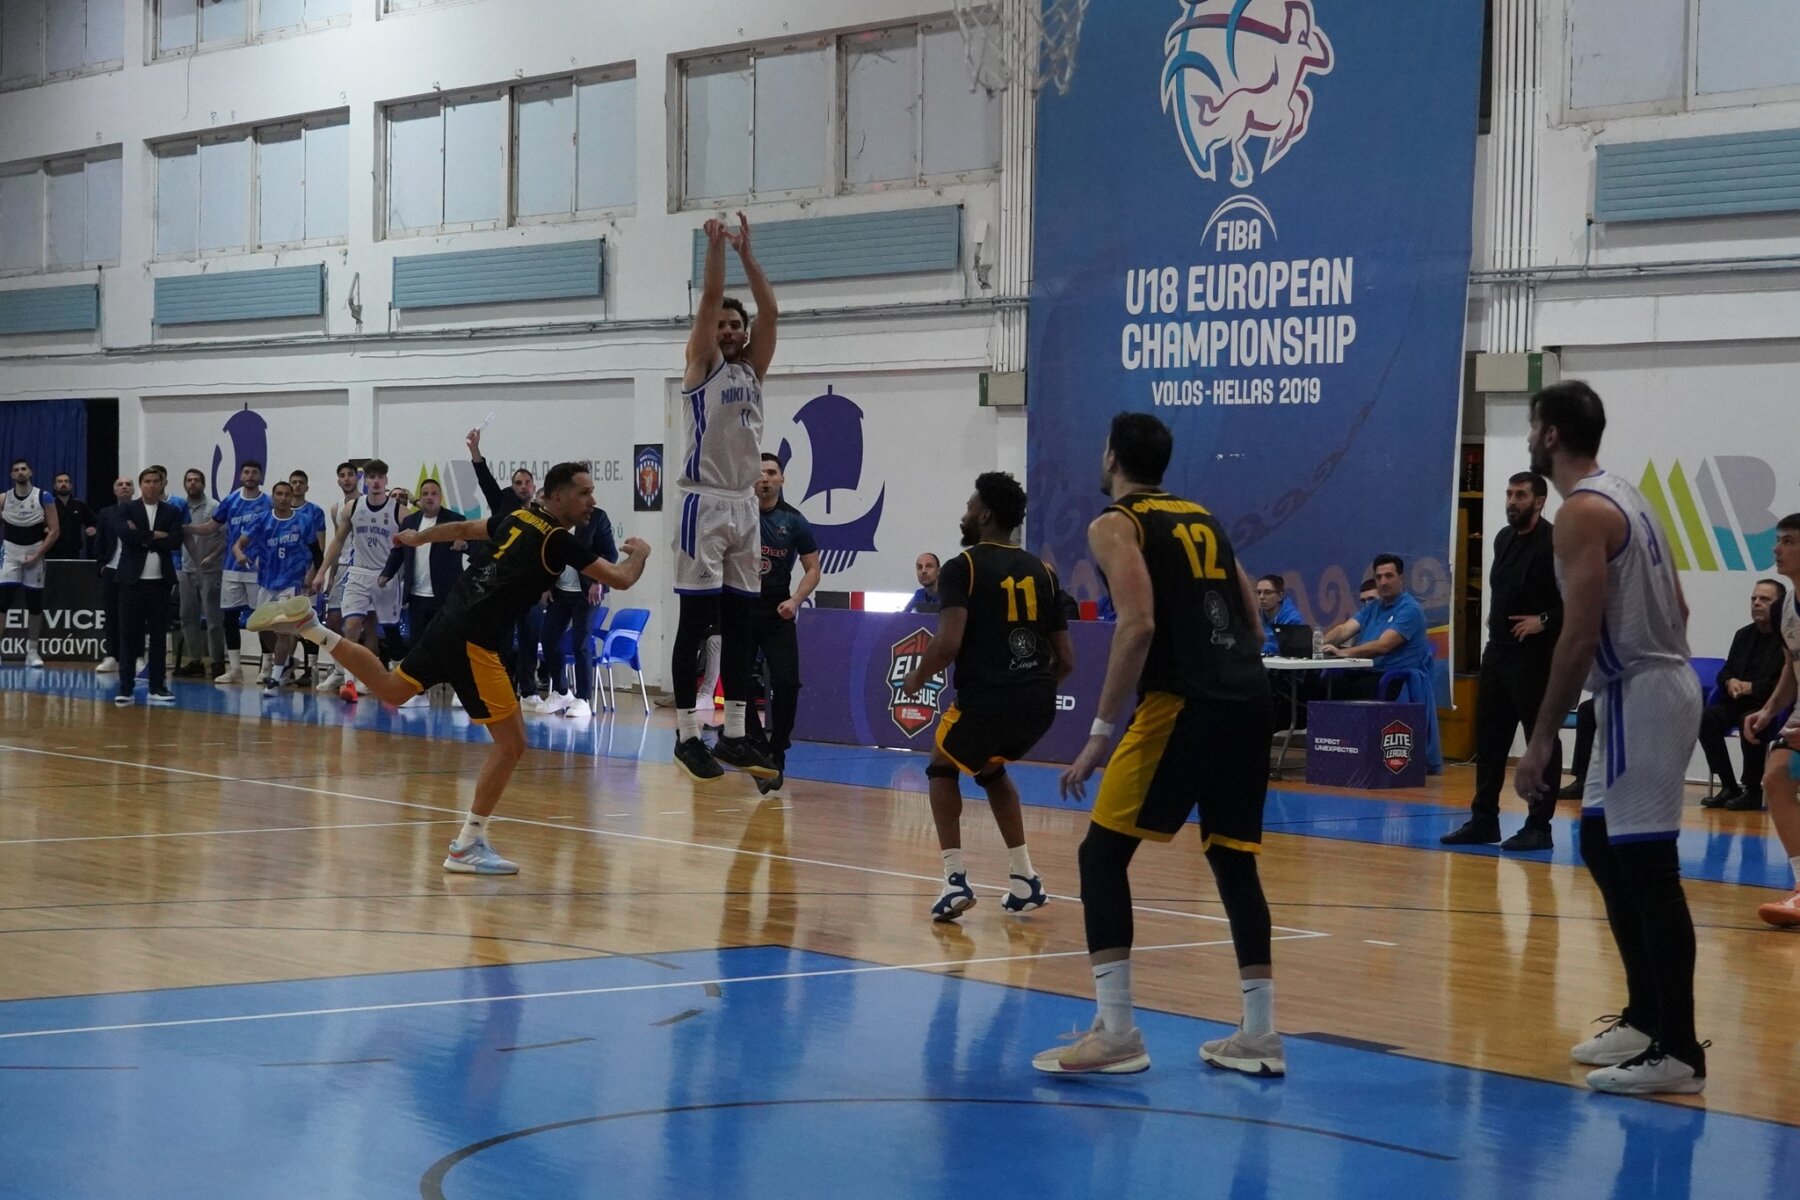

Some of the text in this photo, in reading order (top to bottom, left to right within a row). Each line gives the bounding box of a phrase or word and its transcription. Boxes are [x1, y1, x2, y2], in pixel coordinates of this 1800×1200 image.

[1216, 218, 1261, 252] FIBA
[1125, 257, 1353, 315] U18 EUROPEAN
[1121, 315, 1356, 370] CHAMPIONSHIP
[721, 387, 744, 405] NIKI
[1279, 377, 1321, 404] 2019
[278, 547, 286, 559] 6
[1172, 523, 1227, 580] 12
[1000, 576, 1038, 622] 11
[1314, 737, 1340, 745] EXPECT
[1314, 744, 1359, 754] UNEXPECTED
[1383, 733, 1411, 746] ELITE
[1386, 748, 1408, 758] LEAGUE
